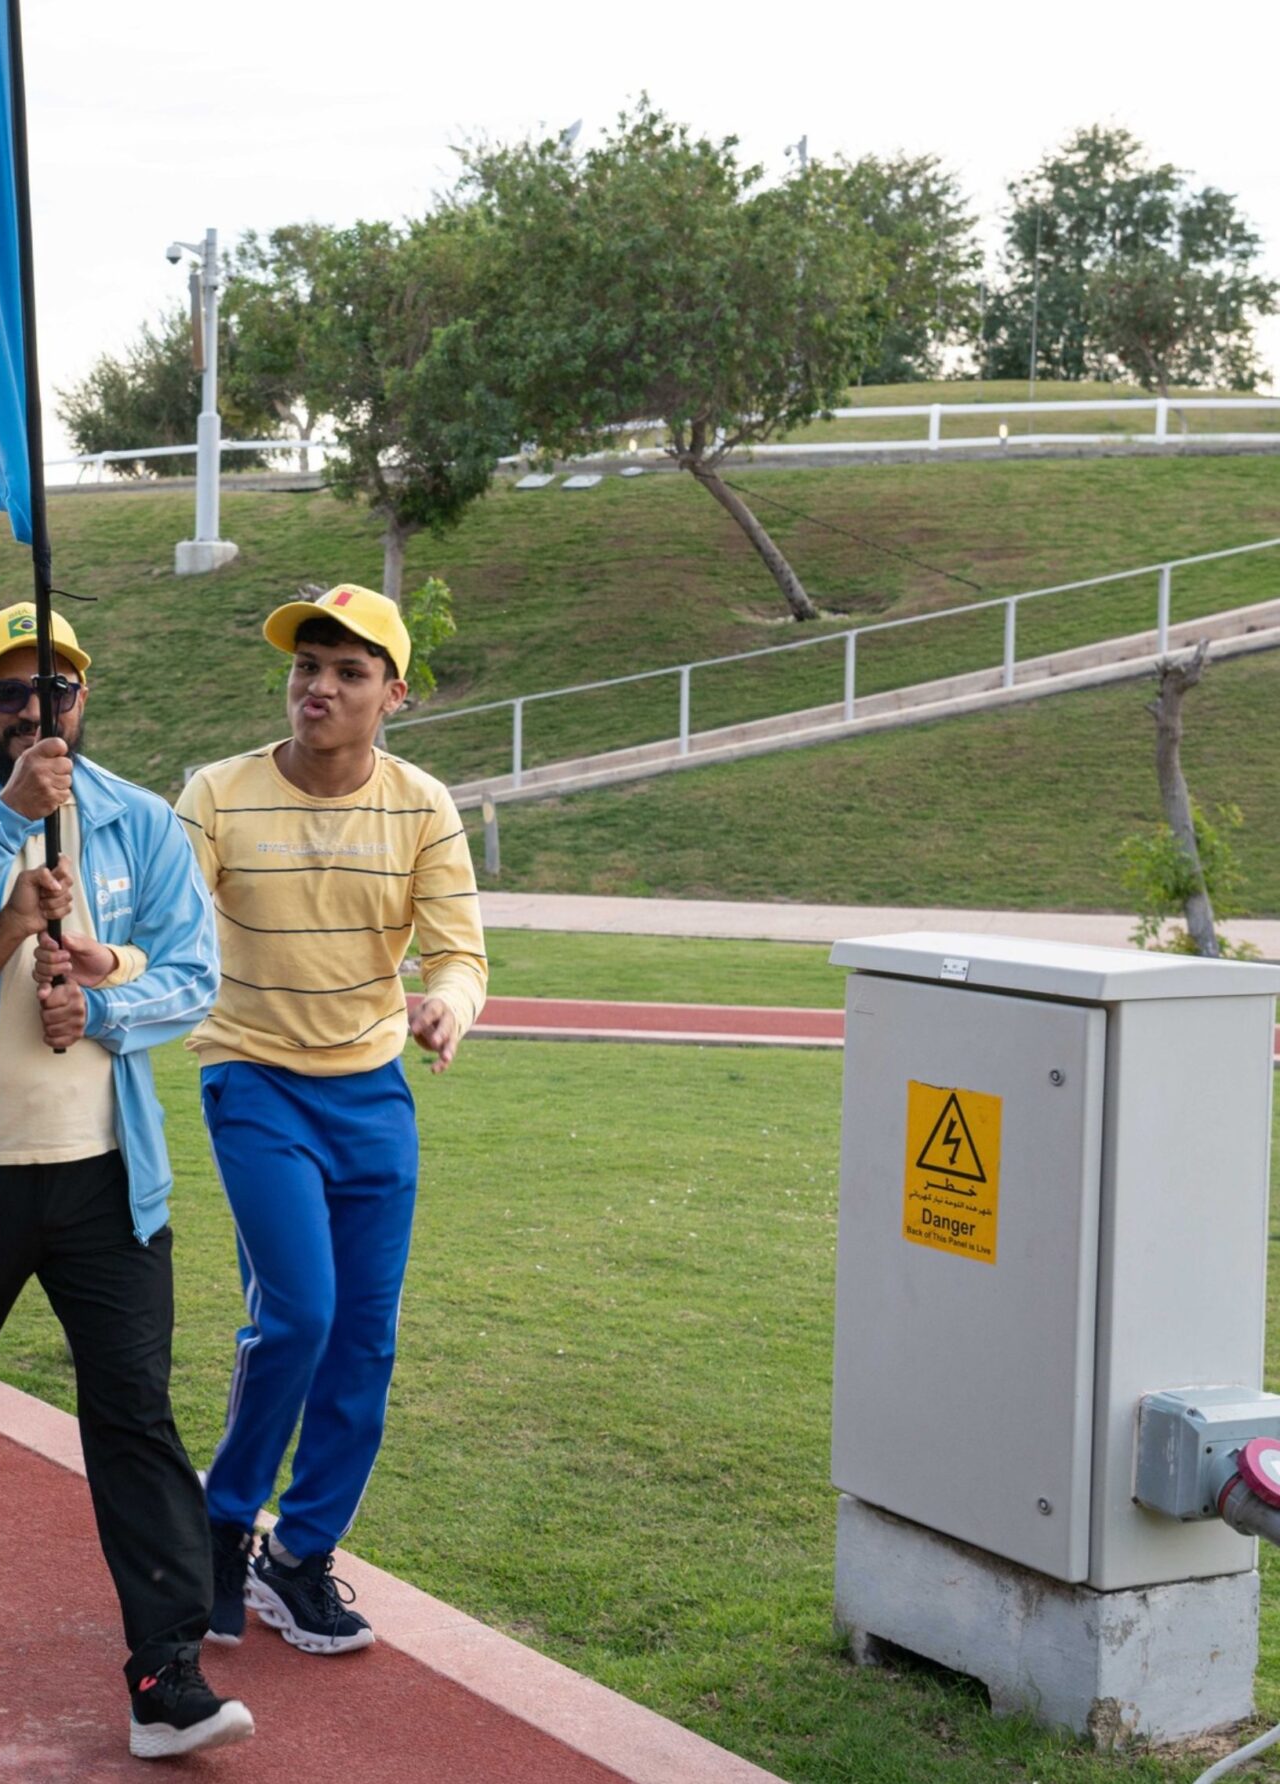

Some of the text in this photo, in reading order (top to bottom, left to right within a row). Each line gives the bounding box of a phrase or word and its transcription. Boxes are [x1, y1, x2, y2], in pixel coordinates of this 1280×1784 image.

[922, 1207, 976, 1236] Danger
[906, 1225, 991, 1256] Back of This Panel is Live
